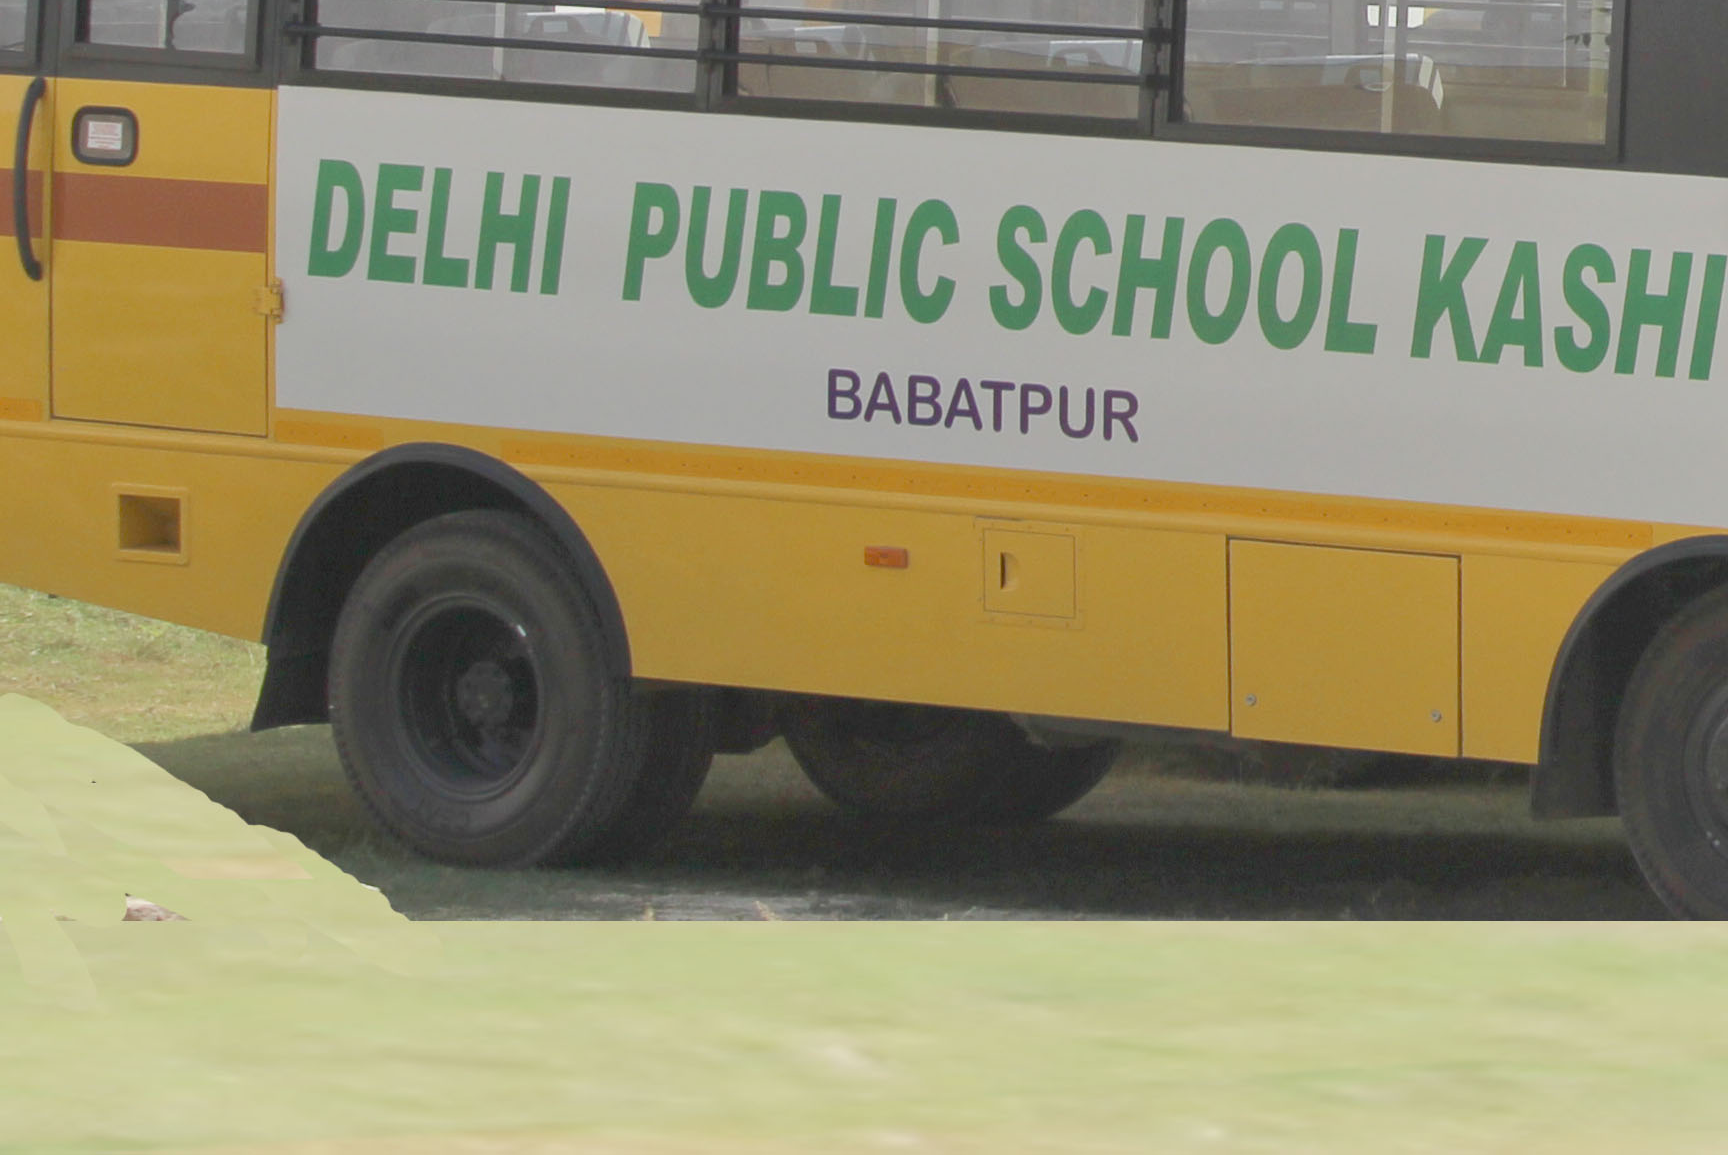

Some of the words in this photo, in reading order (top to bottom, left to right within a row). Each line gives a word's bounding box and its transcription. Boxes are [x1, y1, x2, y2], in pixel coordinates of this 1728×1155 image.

[307, 157, 572, 296] DELHI
[621, 180, 960, 325] PUBLIC
[989, 205, 1379, 356] SCHOOL
[1411, 235, 1728, 382] KASHI
[825, 368, 1140, 444] BABATPUR
